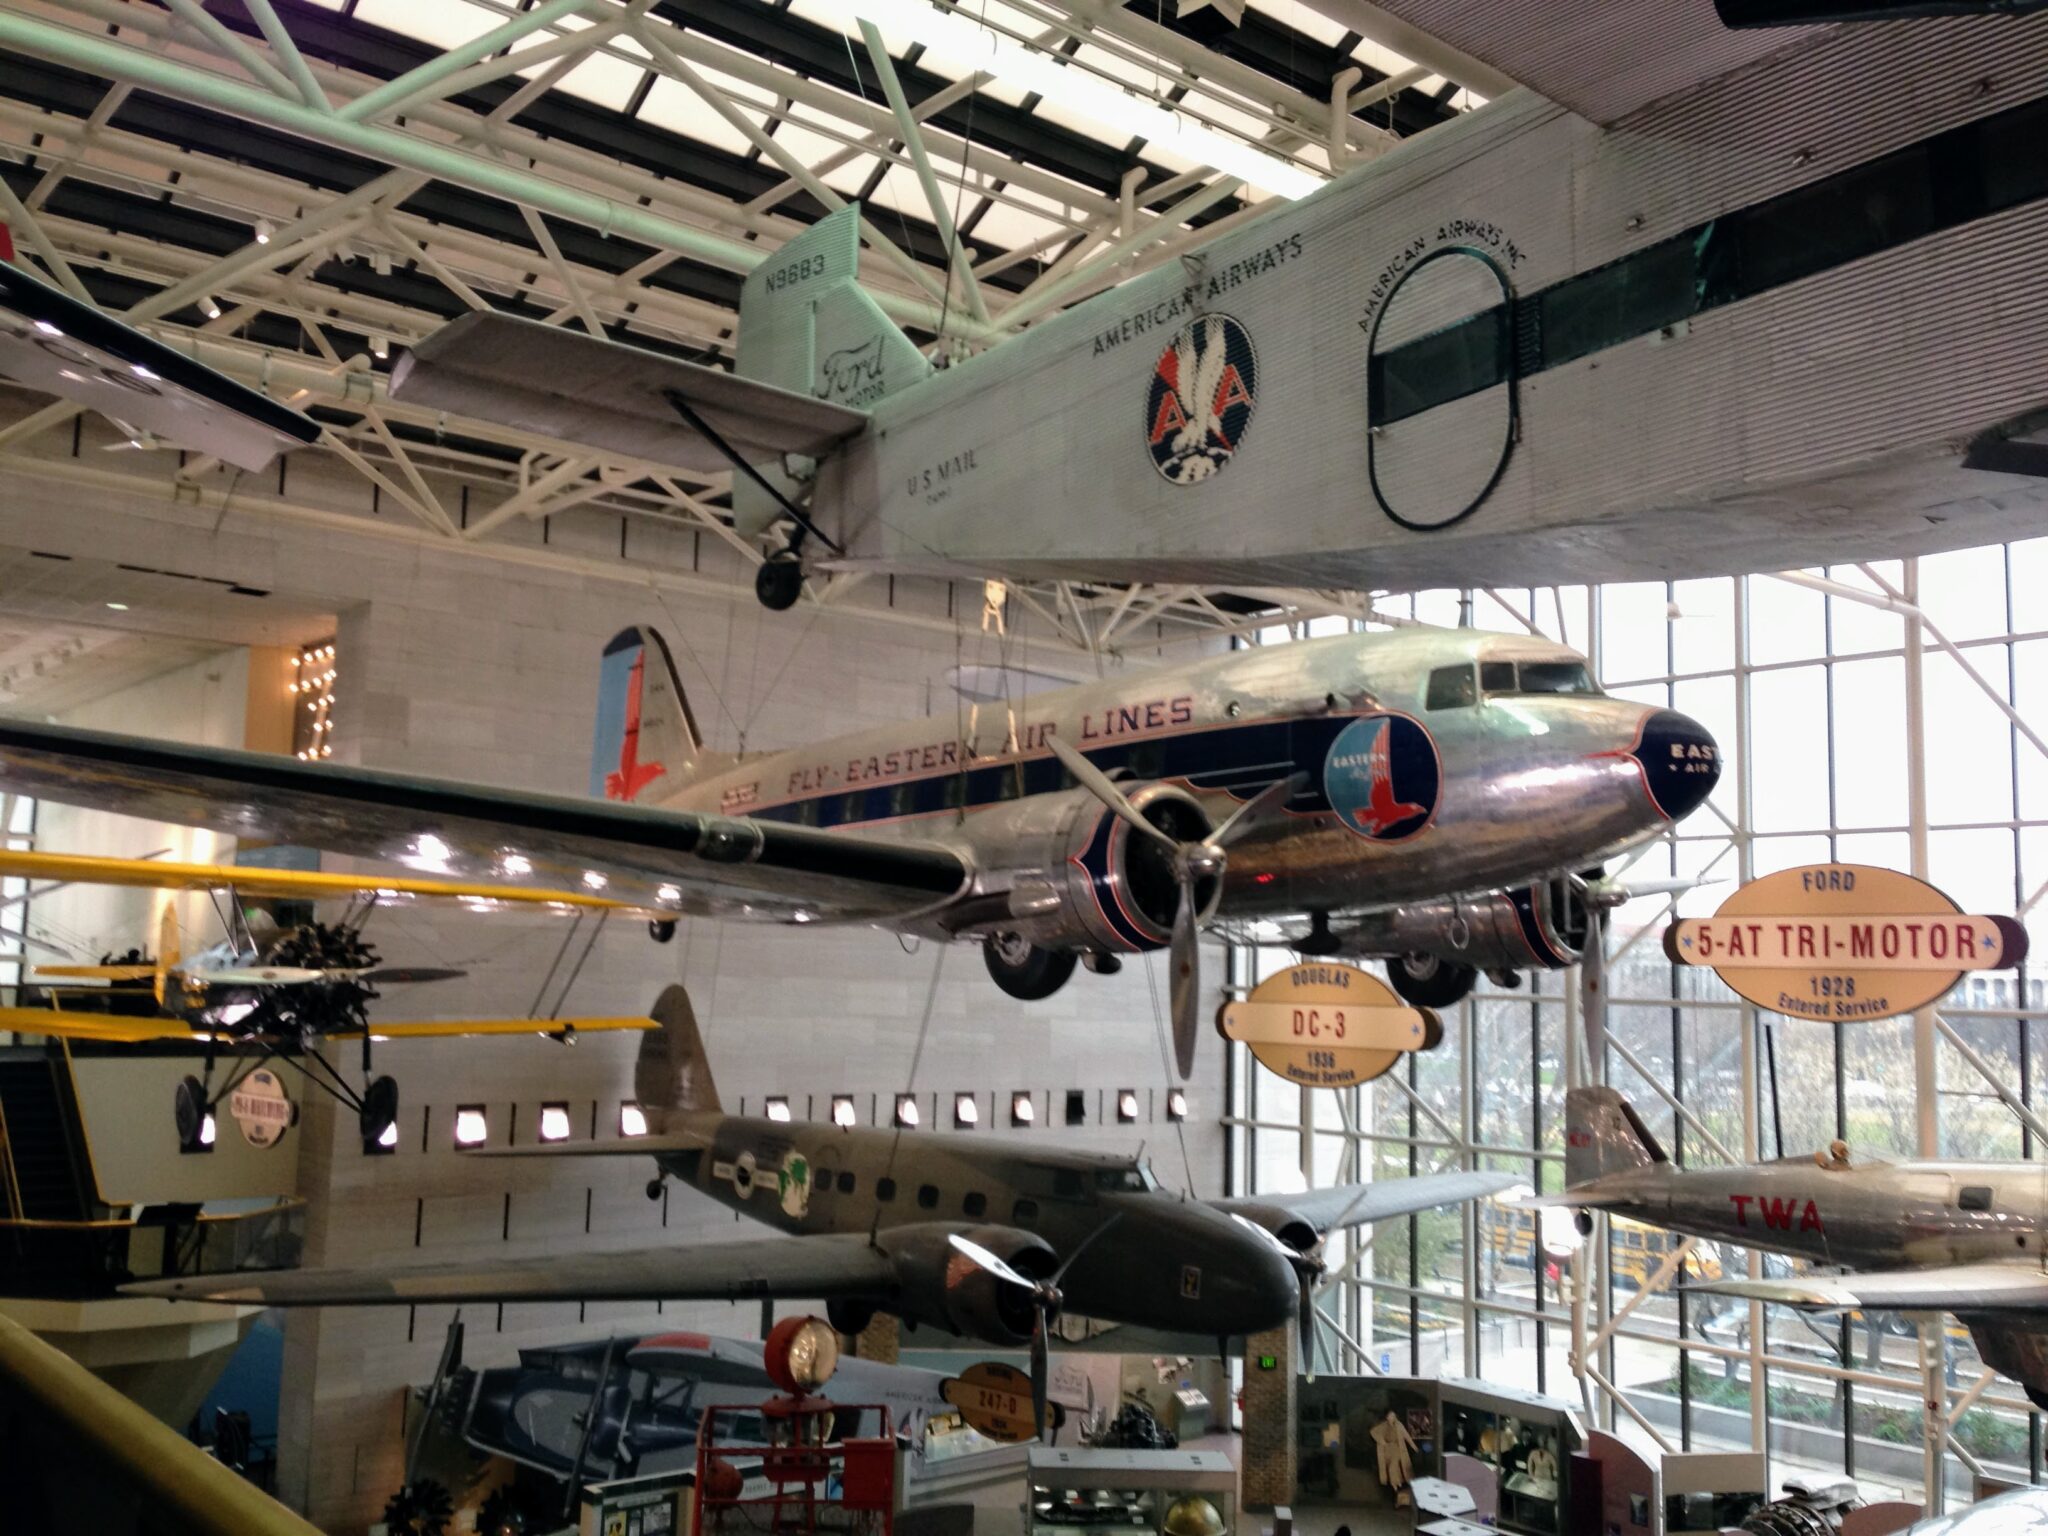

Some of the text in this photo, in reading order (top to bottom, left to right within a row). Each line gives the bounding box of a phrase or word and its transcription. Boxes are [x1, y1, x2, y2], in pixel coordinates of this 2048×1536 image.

[764, 254, 826, 295] N9683
[1357, 237, 1425, 334] AMERICAN
[1092, 233, 1303, 358] AMERICAN AIRWAYS
[817, 334, 886, 401] Ford
[937, 449, 979, 484] MAIL
[787, 765, 829, 794] FLY
[1002, 722, 1056, 754] AIR
[1082, 697, 1193, 740] LINES
[1332, 752, 1387, 769] EASTERN
[1803, 871, 1856, 892] FORD
[1699, 924, 1977, 960] 5-AT TRI-MOTOR
[1292, 968, 1350, 988] DOUGLAS
[1810, 977, 1856, 998] 1928
[1778, 992, 1889, 1017] Entered Service
[1293, 1010, 1346, 1039] DC-3
[1307, 1051, 1336, 1069] 1936
[1729, 1195, 1824, 1234] TWA
[979, 1389, 1017, 1415] 247-D
